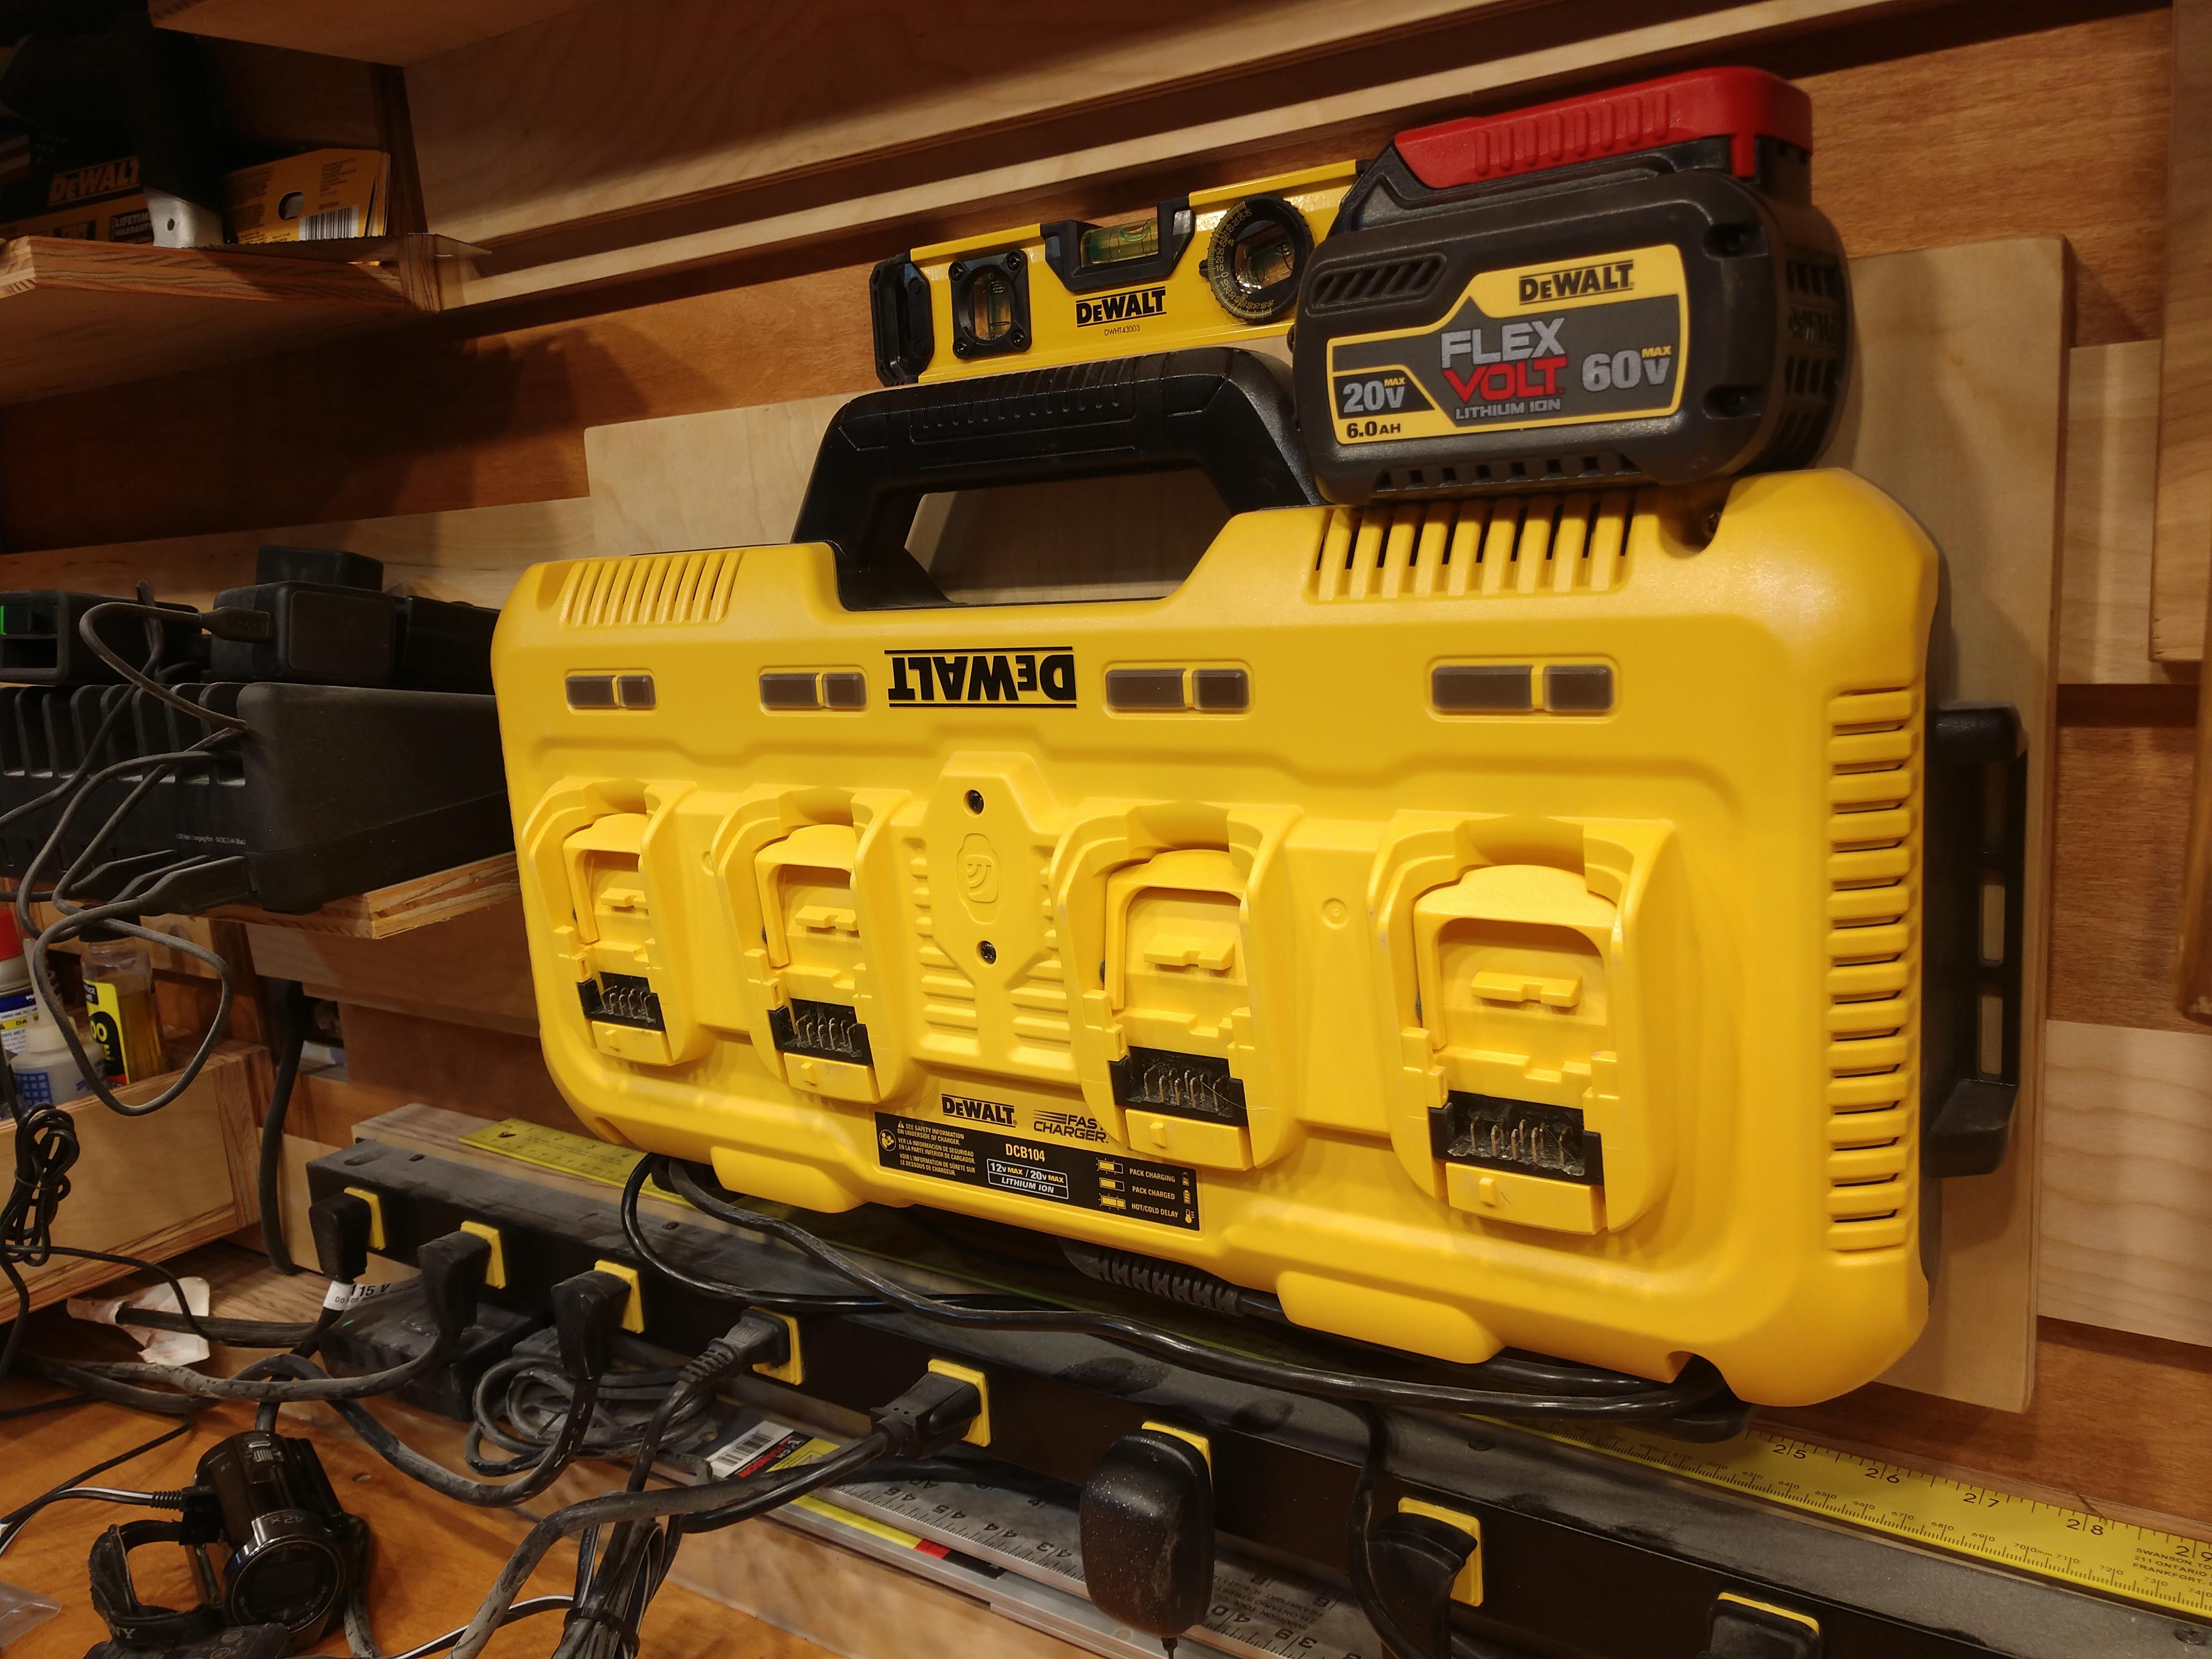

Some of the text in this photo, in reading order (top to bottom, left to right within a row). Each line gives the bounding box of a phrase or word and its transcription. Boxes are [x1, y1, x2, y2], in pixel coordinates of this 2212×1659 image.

[115, 211, 149, 227] LIFETIM
[1216, 247, 1224, 255] 30
[1215, 255, 1224, 264] 20
[1519, 261, 1634, 304] DEWALT
[1076, 288, 1167, 326] DEWALT
[1104, 324, 1140, 336] DWHT43003
[1441, 317, 1565, 368] FLEX
[1641, 346, 1672, 358] MAX
[1384, 377, 1406, 387] MAX
[1443, 356, 1567, 403] VOLT
[1455, 398, 1561, 420] LITHIUM ION
[887, 651, 1077, 704] DEWALT
[941, 1094, 1015, 1126] DEWALT
[1067, 1114, 1103, 1130] FAS
[905, 1129, 930, 1140] UNDERSIDE
[915, 1125, 931, 1134] SAFETY
[932, 1128, 964, 1139] INFORMATION
[1034, 1120, 1107, 1143] CHARGER
[911, 1146, 924, 1154] PARTE
[925, 1149, 944, 1158] INFERIOR
[949, 1147, 974, 1157] SEGURIDAD
[1005, 1142, 1046, 1162] DCB104
[906, 1160, 925, 1170] DESSOUS
[1007, 1166, 1023, 1175] MAX
[1025, 1168, 1029, 1177] /
[1047, 1175, 1064, 1183] MAX
[1129, 1168, 1176, 1182] PACK CHARGING
[1001, 1177, 1055, 1193] LITHIUM ION
[1132, 1186, 1176, 1200] PACK CHARGED
[1131, 1203, 1178, 1218] HOT/COLD DELAY
[1772, 1444, 1807, 1459] 25
[1865, 1468, 1900, 1484] 26
[1963, 1493, 2000, 1508] 27
[932, 1503, 967, 1520] 45
[983, 1522, 1018, 1538] 44
[2065, 1519, 2104, 1536] 28
[1036, 1541, 1073, 1559] 43
[2136, 1548, 2192, 1566] SWANSON
[2174, 1546, 2212, 1562] 29
[2155, 1561, 2207, 1577] ONTARIO
[1211, 1605, 1251, 1622] 40
[1275, 1628, 1318, 1649] 39
